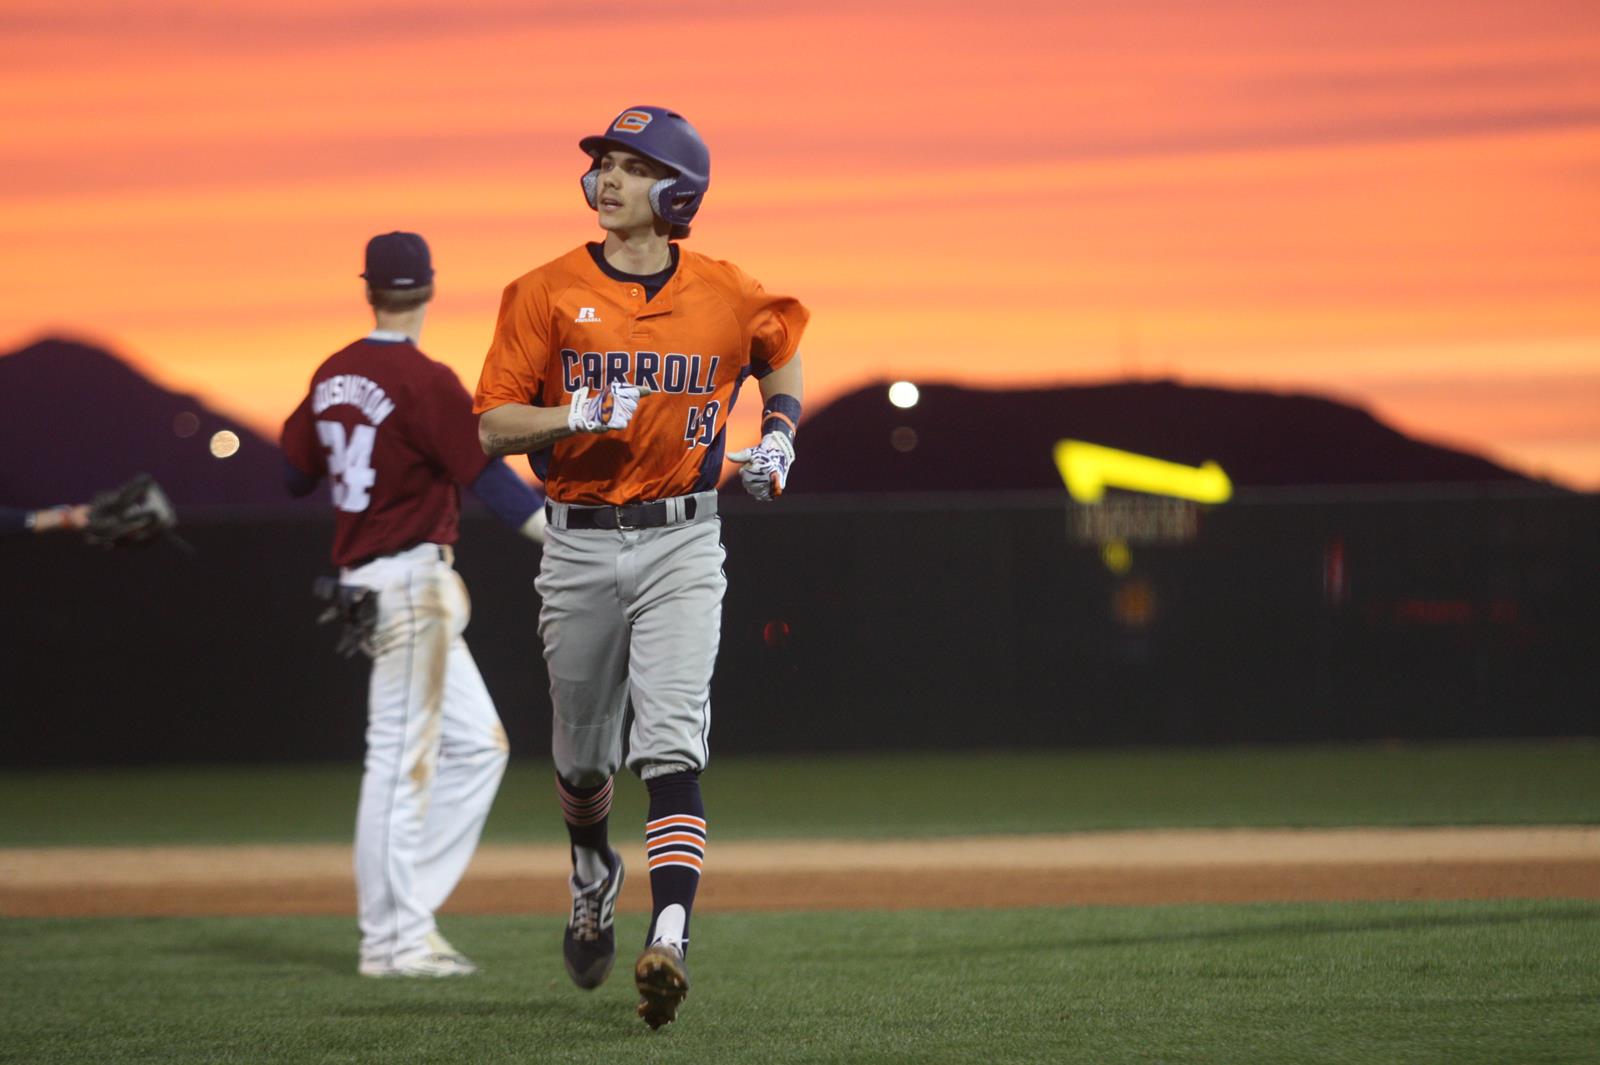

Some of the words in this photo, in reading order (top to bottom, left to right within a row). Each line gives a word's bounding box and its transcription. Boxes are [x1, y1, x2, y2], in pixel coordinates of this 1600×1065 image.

[613, 110, 653, 134] C
[560, 348, 720, 395] CARROLL
[684, 400, 720, 450] 49
[316, 420, 377, 513] 34
